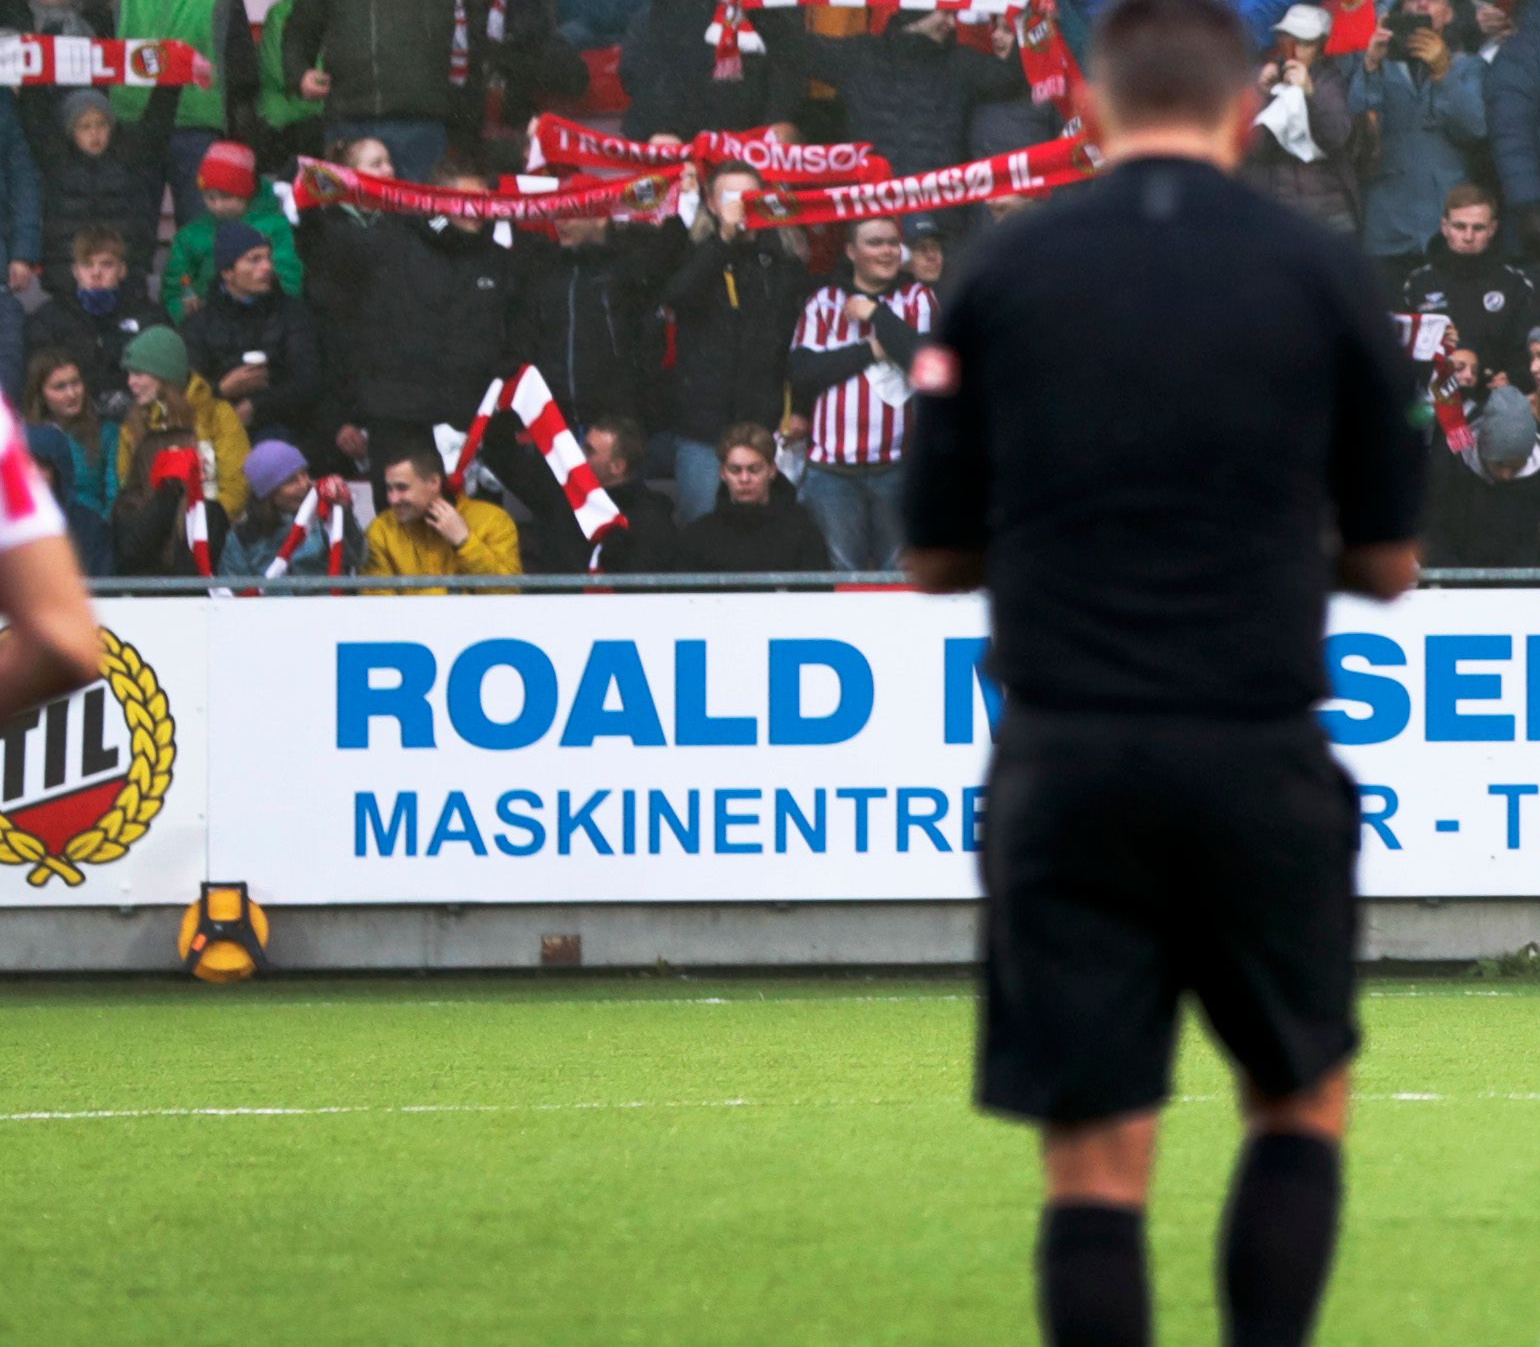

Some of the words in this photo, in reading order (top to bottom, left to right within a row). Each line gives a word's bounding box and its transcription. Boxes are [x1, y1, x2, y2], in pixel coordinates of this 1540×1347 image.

[823, 160, 995, 218] TROMSØ
[0, 686, 119, 803] TIL
[335, 637, 875, 750] ROALD
